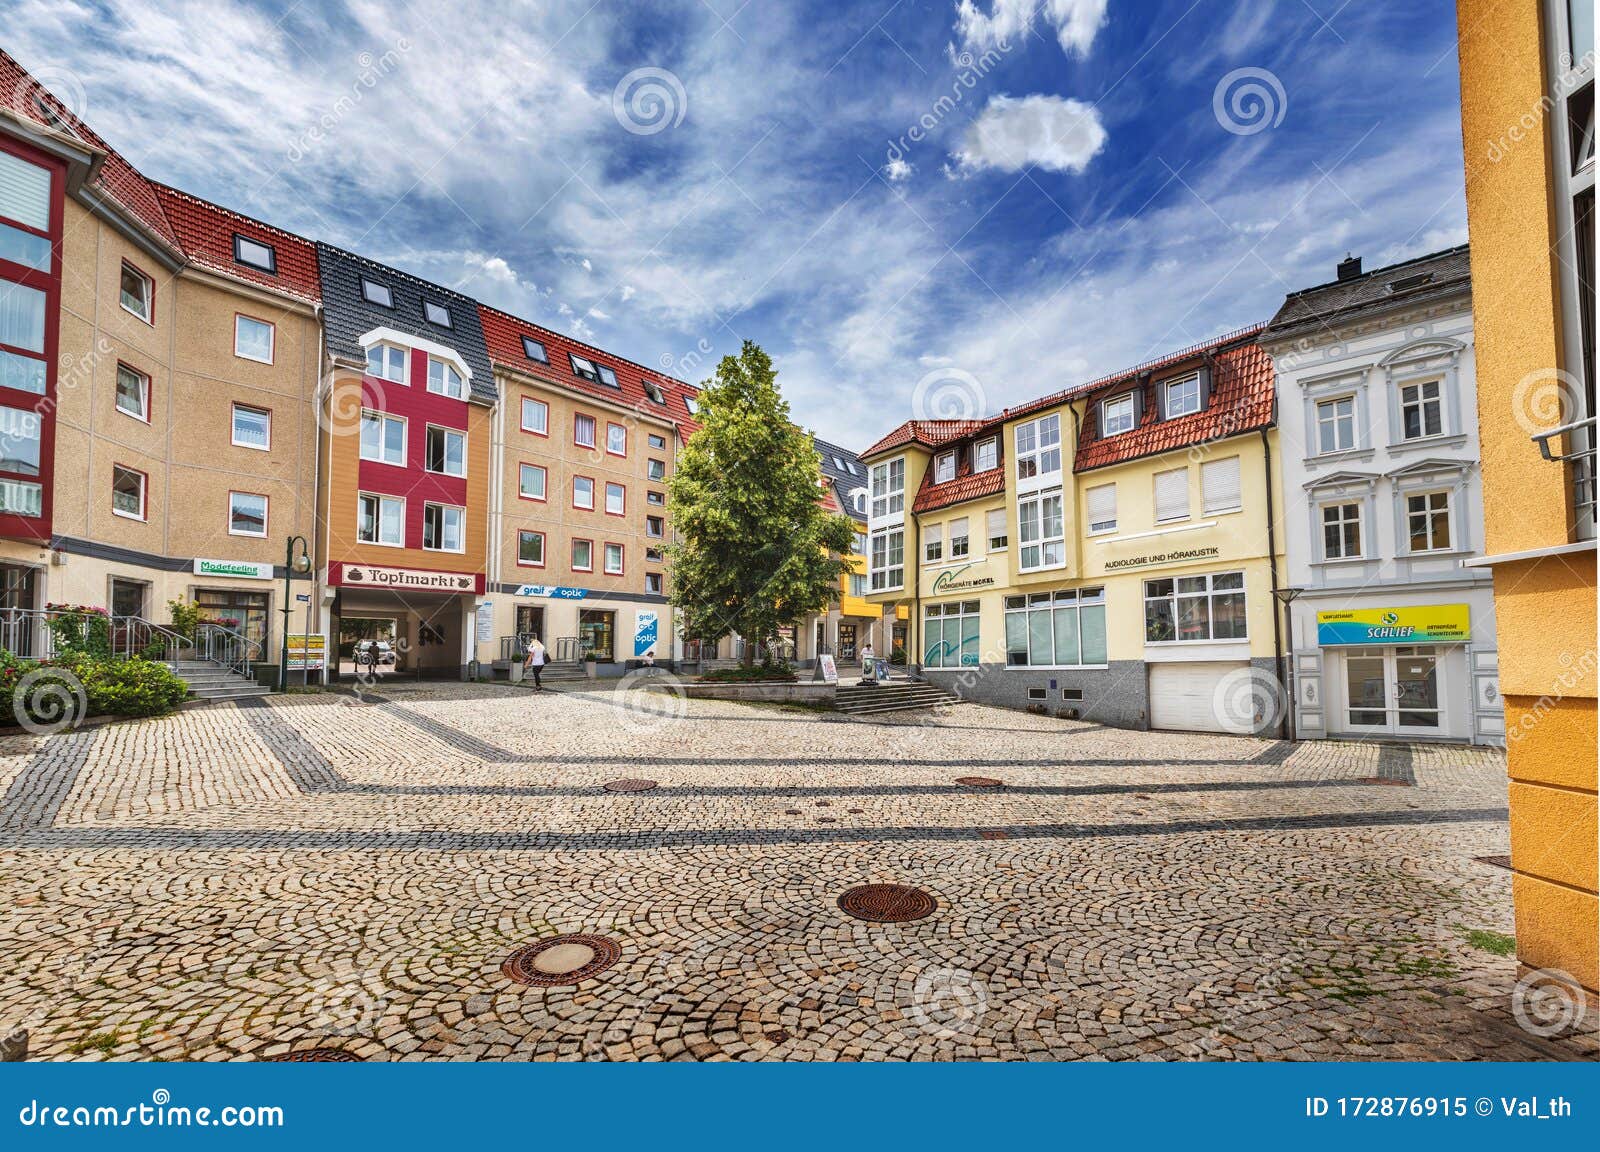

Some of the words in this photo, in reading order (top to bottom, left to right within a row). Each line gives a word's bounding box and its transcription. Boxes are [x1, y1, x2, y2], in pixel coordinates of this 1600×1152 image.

[1104, 556, 1148, 569] AUDIOLOGIE
[1148, 554, 1166, 563] UND
[1167, 547, 1219, 560] HÖRAKUSTIK
[200, 561, 258, 573] Modefeeling
[368, 569, 455, 587] Topfmarkt
[561, 589, 582, 598] optic
[635, 633, 656, 644] optic
[1367, 626, 1416, 639] SCHLIEF
